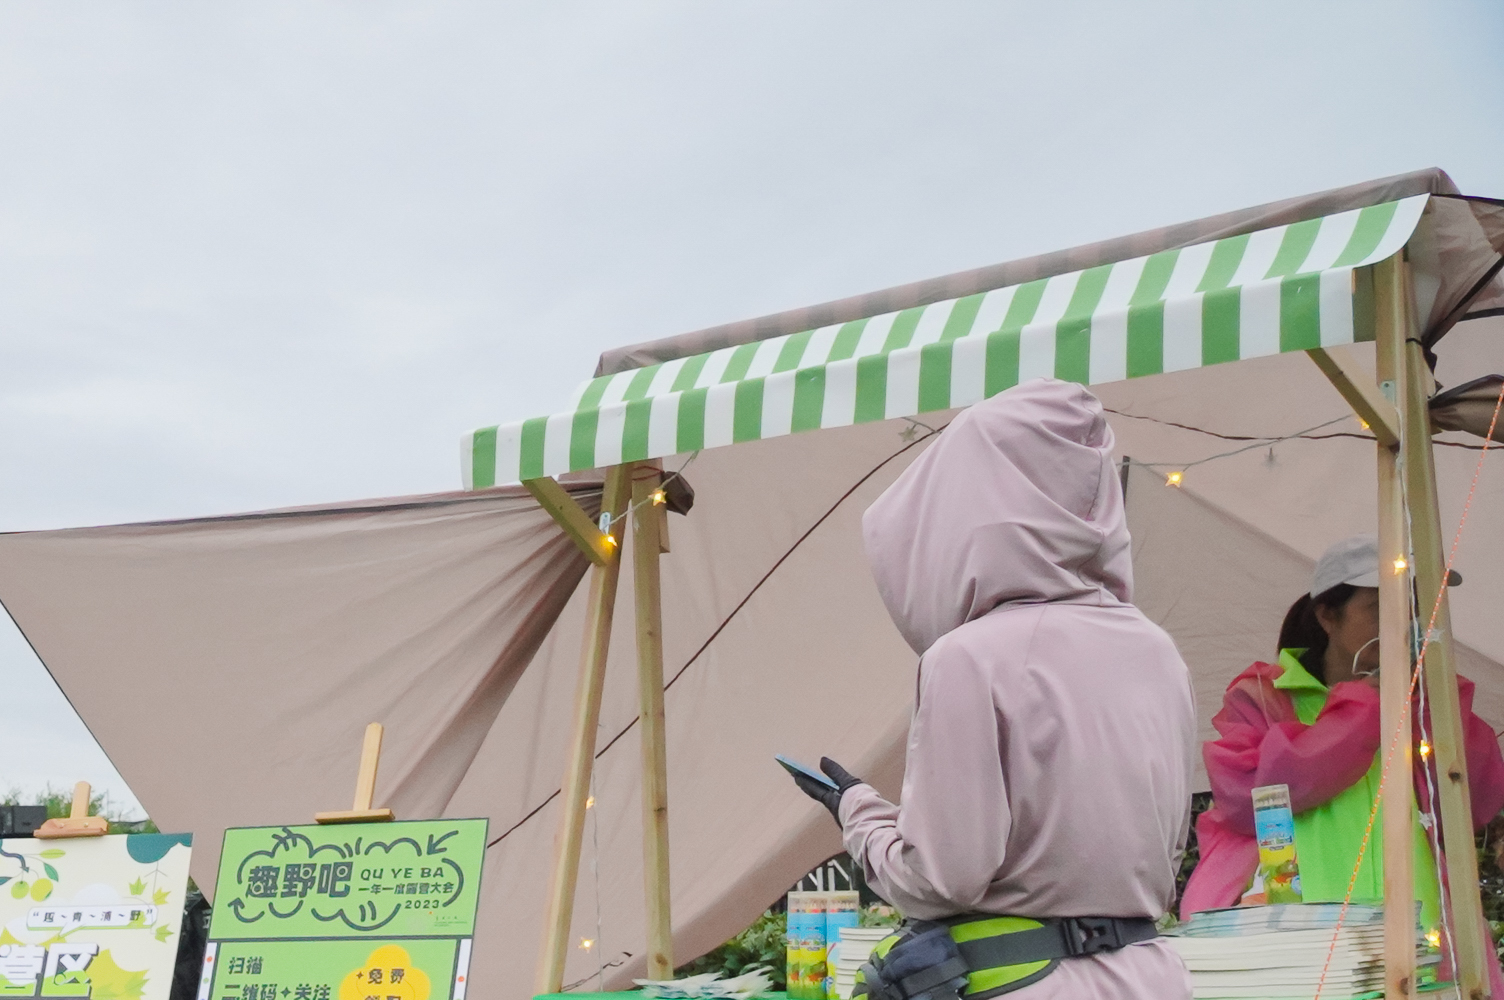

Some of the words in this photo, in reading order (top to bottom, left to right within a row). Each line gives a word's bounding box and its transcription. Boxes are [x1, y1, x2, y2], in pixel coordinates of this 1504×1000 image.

[245, 861, 353, 898] 趣野吧
[360, 868, 383, 881] QU
[391, 867, 413, 879] YE
[420, 867, 444, 878] BA
[404, 899, 440, 909] 2023
[228, 956, 264, 974] 扫描
[368, 968, 405, 984] 免费
